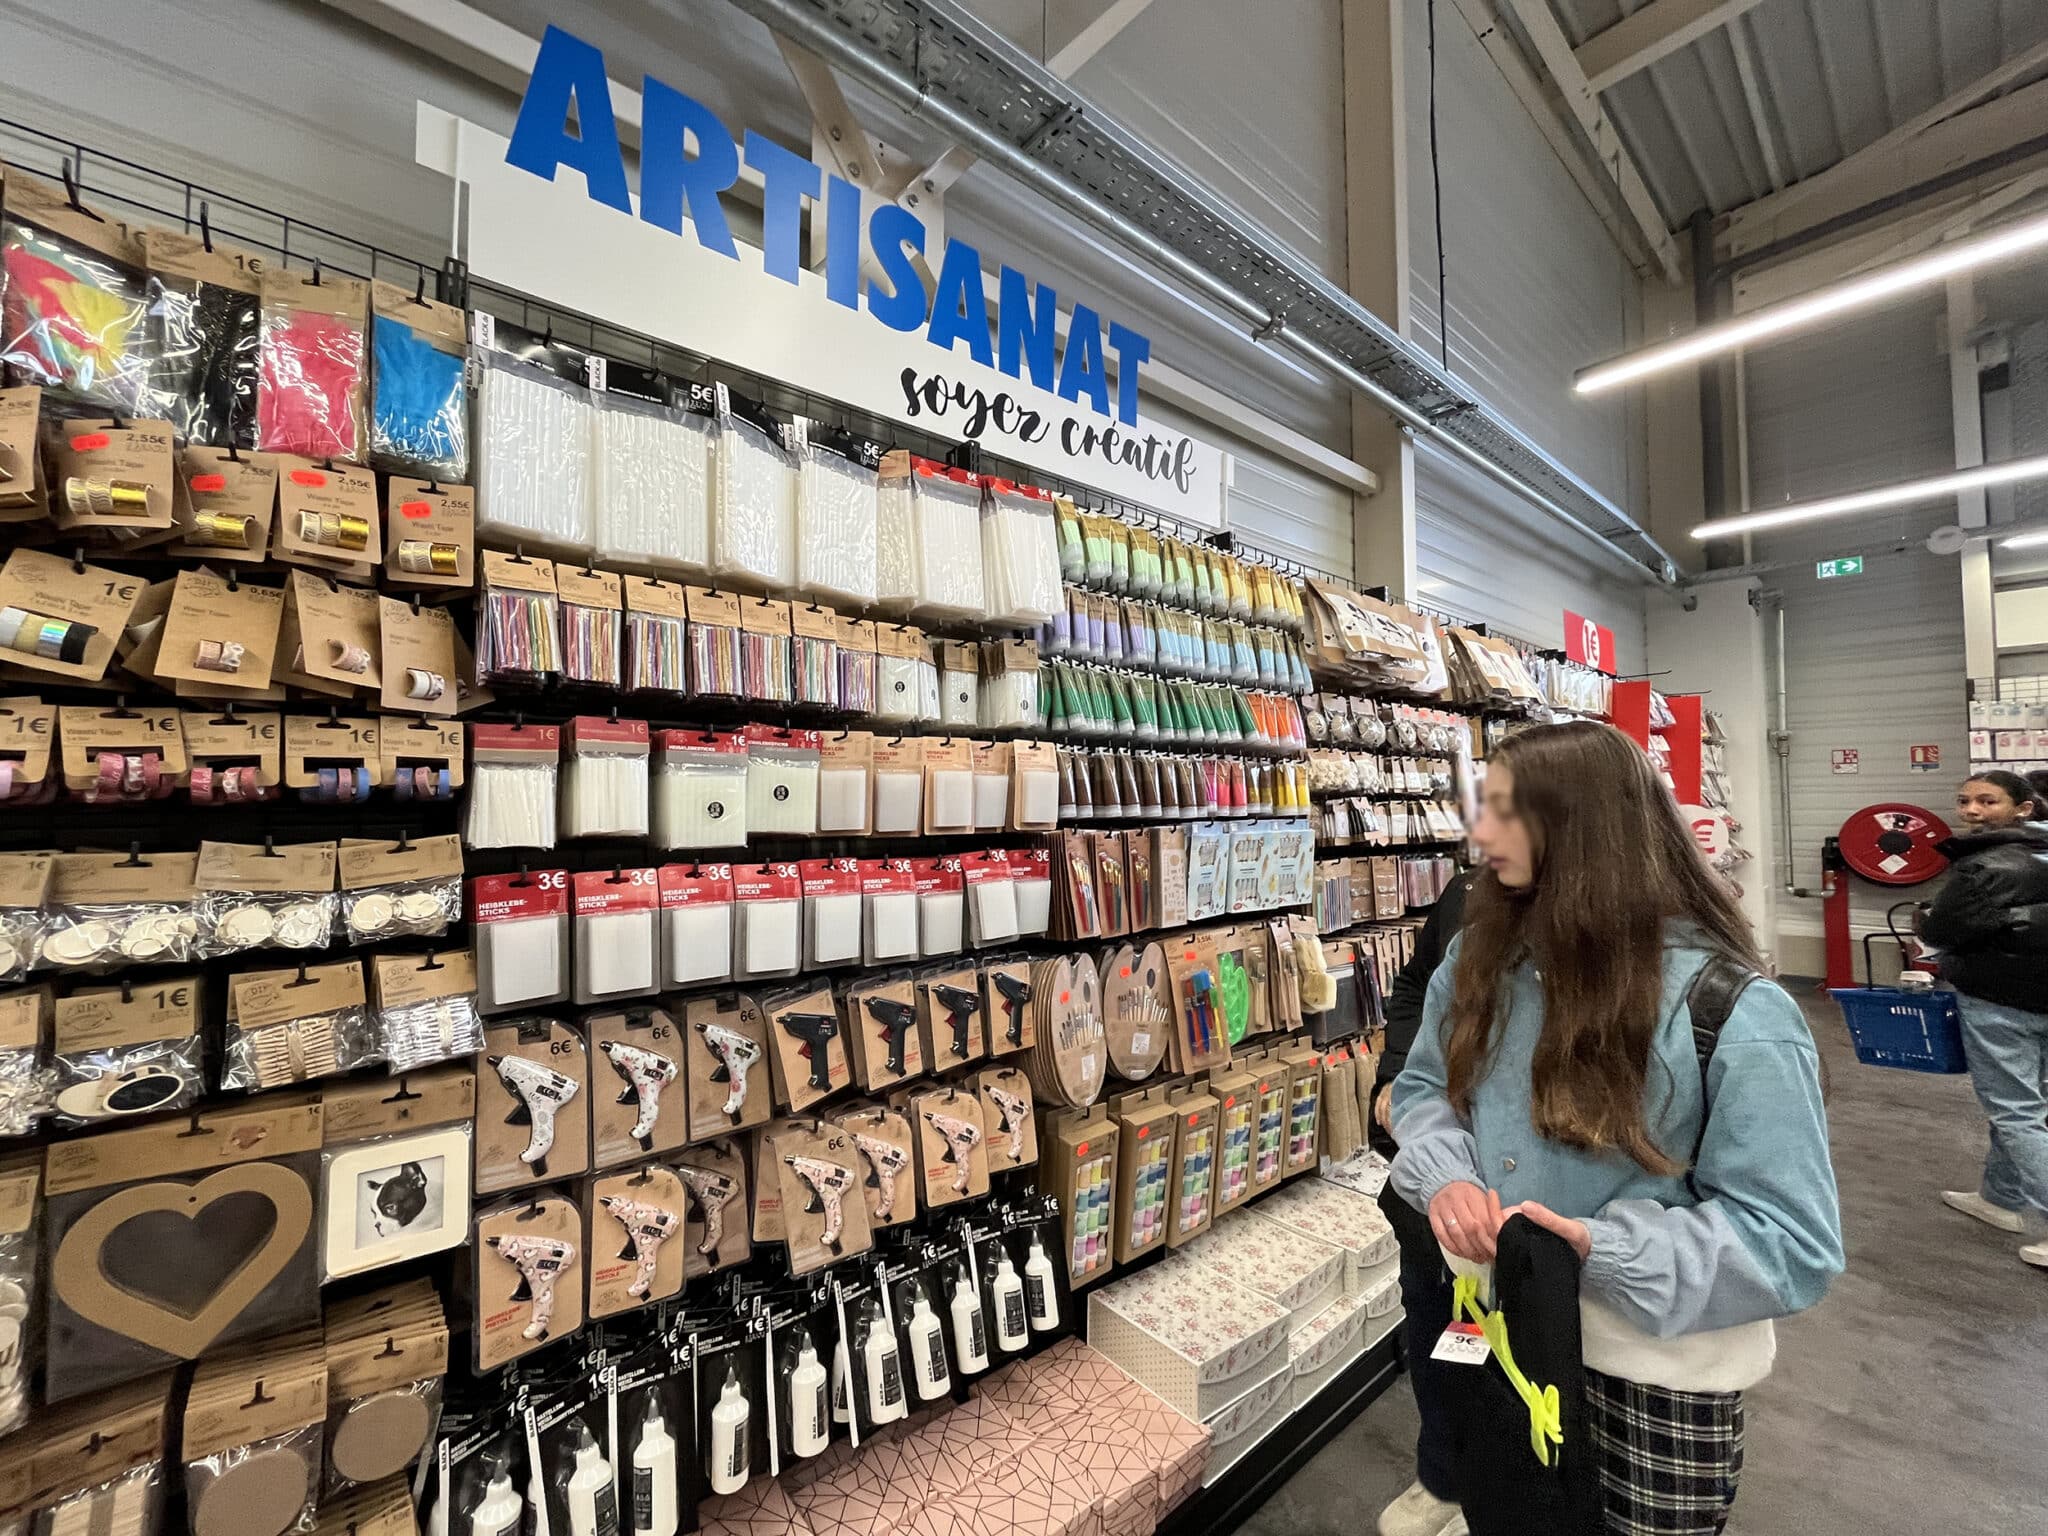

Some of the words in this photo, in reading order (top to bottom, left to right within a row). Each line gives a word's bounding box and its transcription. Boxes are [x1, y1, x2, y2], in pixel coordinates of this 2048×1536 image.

[505, 23, 1151, 428] ARTISANAT
[234, 254, 264, 275] 1€
[691, 384, 714, 403] 5€
[900, 366, 1050, 443] soyez
[1062, 416, 1197, 494] créatif
[863, 441, 881, 459] 5€
[534, 566, 551, 578] 1€
[104, 582, 137, 600] 1€
[602, 581, 617, 592] 1€
[667, 591, 681, 601] 1€
[724, 601, 737, 610] 1€
[776, 612, 788, 623] 1€
[823, 616, 835, 626] 1€
[907, 634, 919, 645] 1€
[1584, 625, 1599, 661] 1€
[12, 716, 49, 734] 1€
[143, 718, 176, 732] 1€
[630, 724, 646, 735] 1€
[246, 725, 275, 740] 1€
[350, 729, 376, 744] 1€
[437, 731, 460, 746] 1€
[538, 728, 555, 741] 1€
[804, 731, 818, 742] 1€
[731, 735, 746, 747] 1€
[991, 849, 1008, 862] 3€
[1036, 849, 1049, 862] 3€
[709, 864, 732, 881] 3€
[778, 864, 799, 878] 3€
[839, 859, 859, 873] 3€
[894, 859, 912, 873] 3€
[946, 859, 962, 873] 3€
[538, 871, 566, 890] 3€
[631, 868, 656, 886] 3€
[578, 901, 607, 909] STICKS
[663, 894, 689, 902] STICKS
[479, 907, 511, 917] STICKS
[152, 987, 189, 1009] 1€
[740, 1009, 757, 1023] 6€
[652, 1025, 671, 1039] 6€
[551, 1039, 572, 1055] 6€
[828, 1135, 845, 1151] 6€
[1044, 1198, 1059, 1211] 1€
[1001, 1212, 1016, 1226] 1€
[920, 1244, 937, 1261] 1€
[810, 1287, 827, 1304] 1€
[734, 1298, 749, 1317] 1€
[745, 1317, 766, 1334] 1€
[661, 1328, 679, 1349] 1€
[1455, 1335, 1478, 1346] 9€
[670, 1345, 691, 1364] 1€
[588, 1367, 609, 1390] 1€
[507, 1394, 528, 1418] 1€
